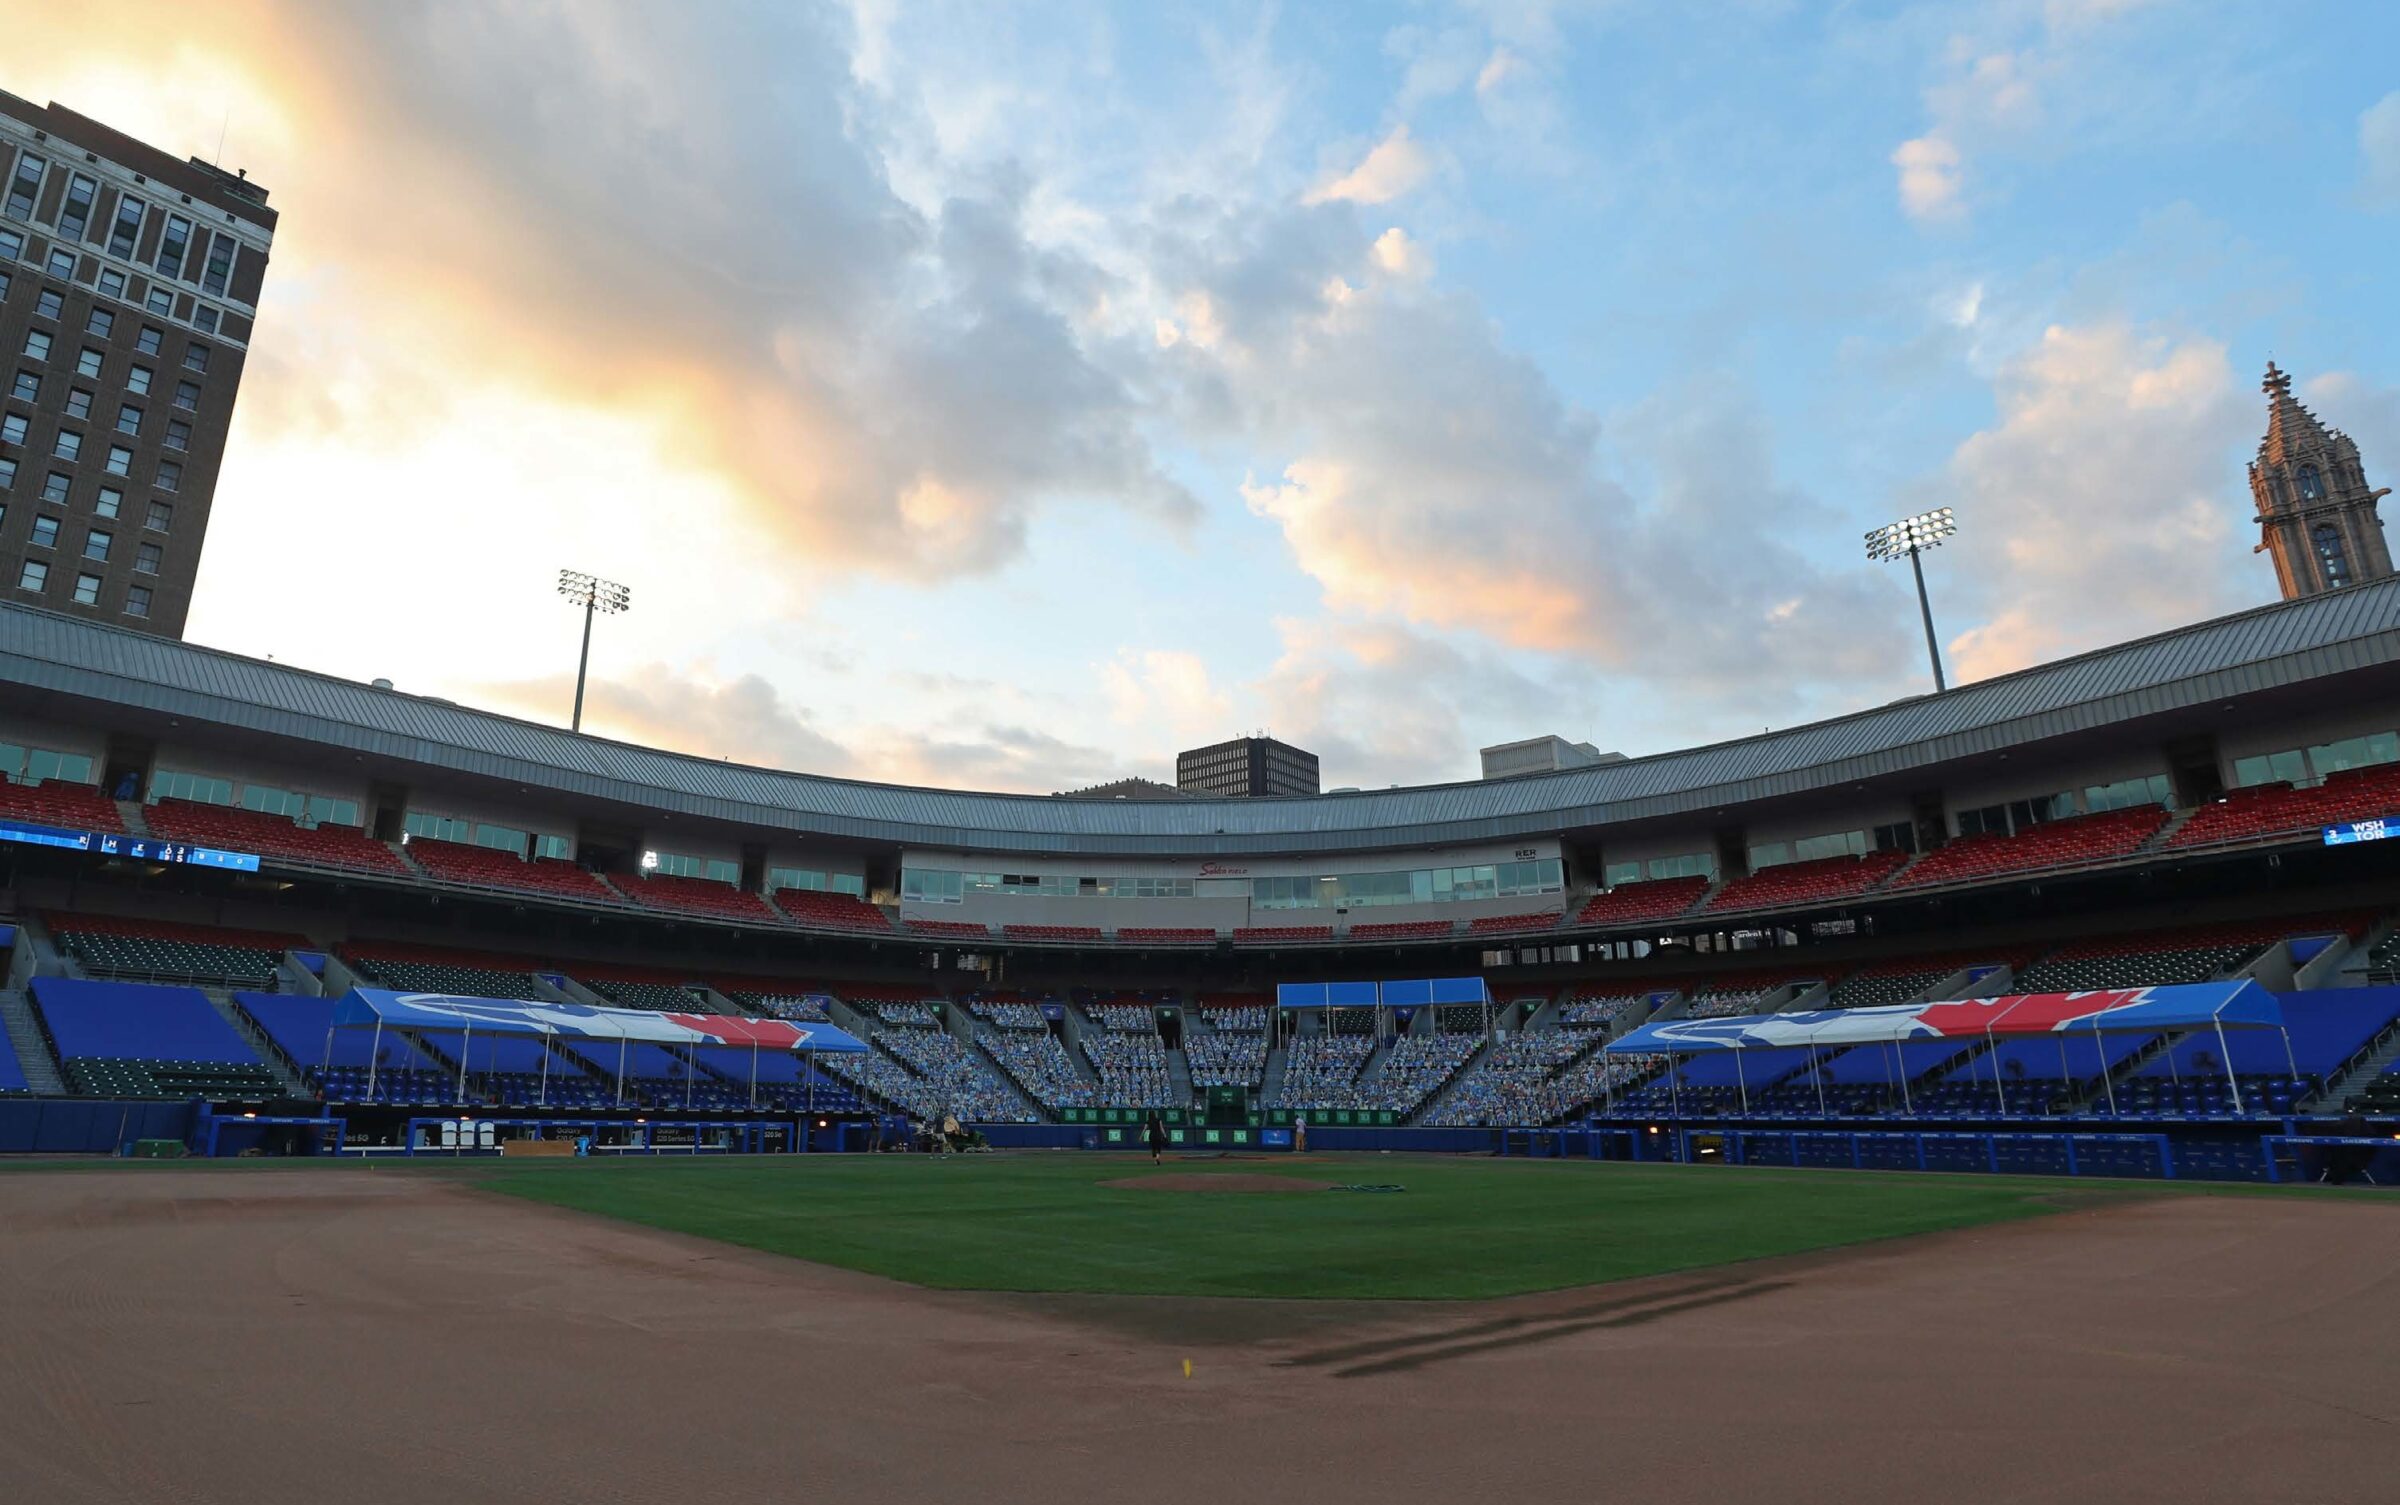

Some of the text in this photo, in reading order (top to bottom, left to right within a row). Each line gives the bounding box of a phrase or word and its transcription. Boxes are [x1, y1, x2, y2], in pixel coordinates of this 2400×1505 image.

[2352, 820, 2385, 832] WSH
[2328, 830, 2337, 838] 3
[2354, 830, 2385, 841] TOR
[79, 836, 144, 852] R H E
[177, 847, 184, 855] 3
[175, 855, 183, 863] 5
